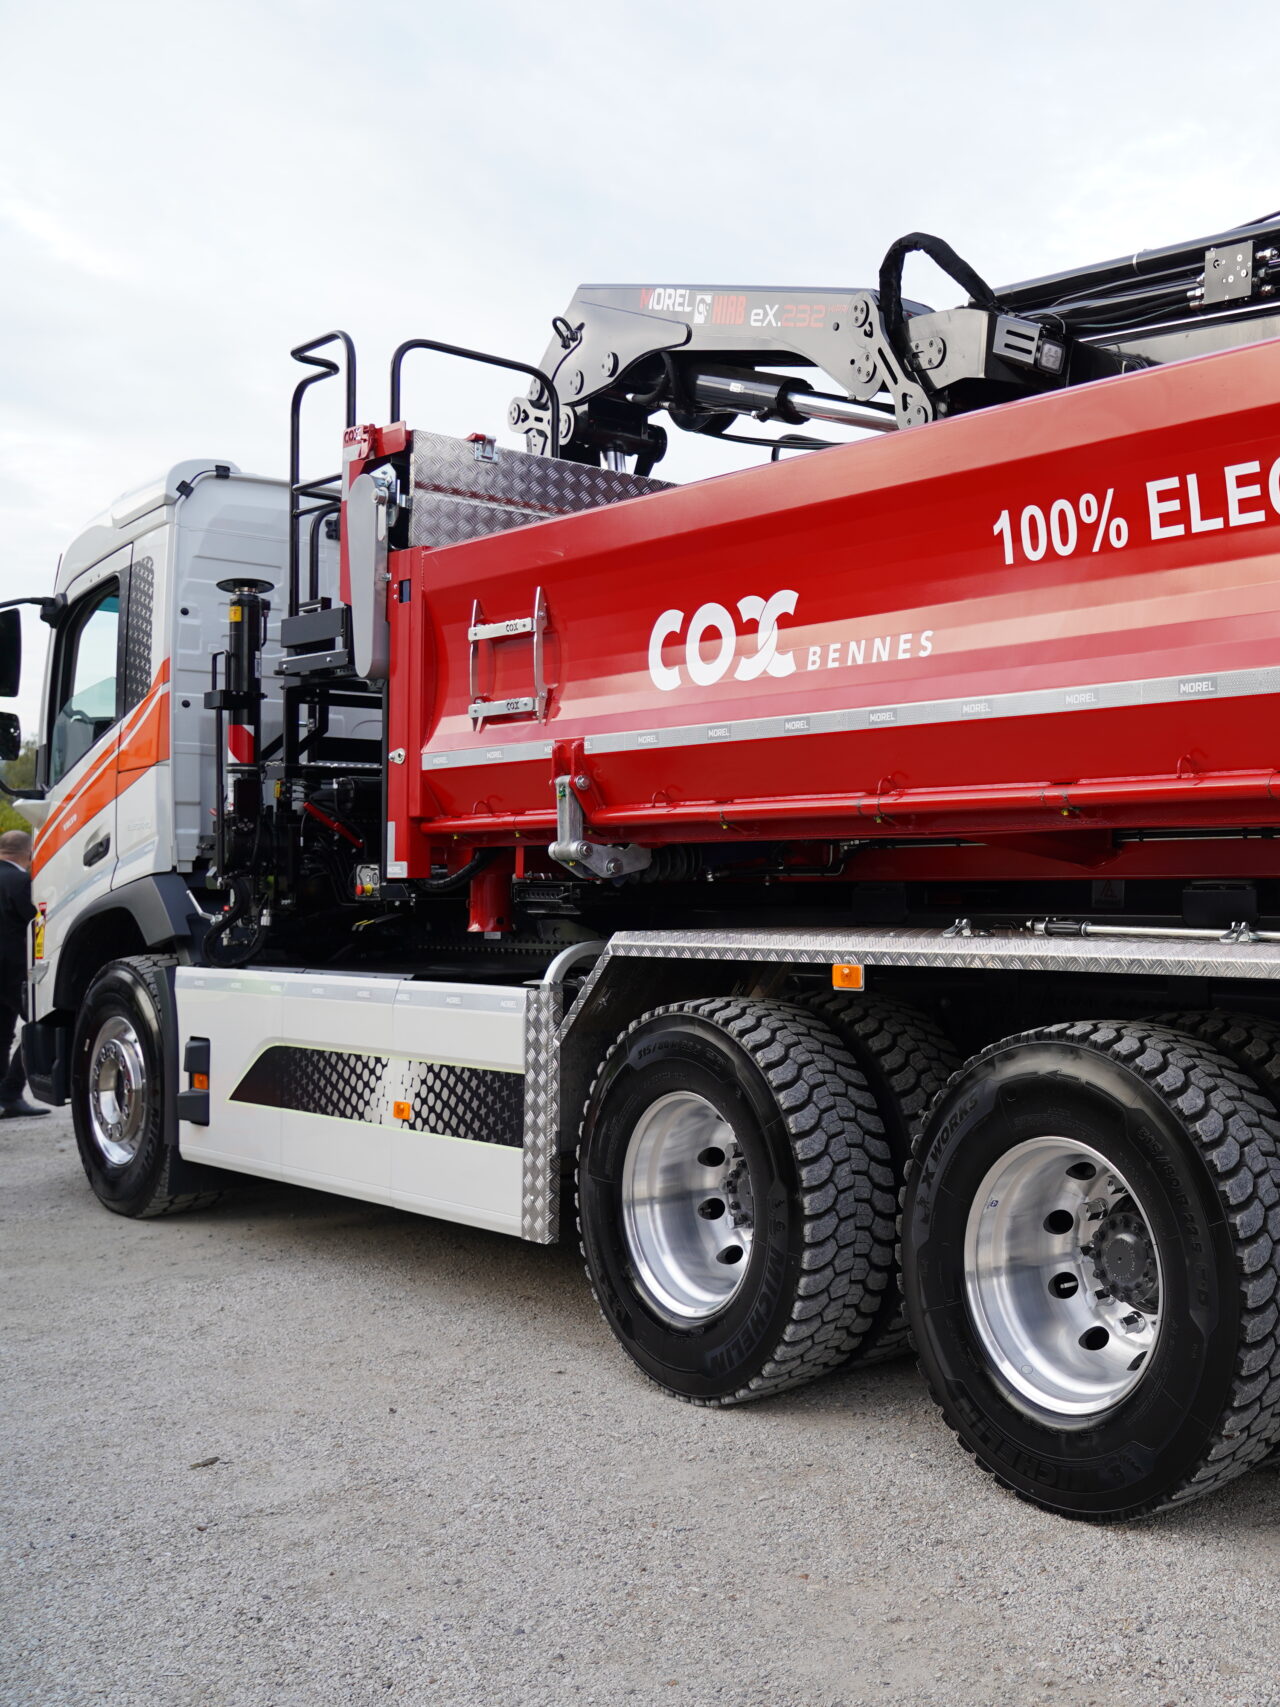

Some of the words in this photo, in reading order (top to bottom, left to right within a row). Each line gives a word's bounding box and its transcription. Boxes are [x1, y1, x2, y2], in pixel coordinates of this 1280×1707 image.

[640, 288, 693, 312] MOREL
[712, 295, 747, 325] HIAB
[993, 488, 1129, 565] 100%
[505, 623, 519, 632] COX
[648, 589, 799, 691] COX
[807, 630, 934, 671] BENNES
[1179, 680, 1215, 694] MOREL
[1065, 692, 1097, 706] MOREL
[506, 701, 519, 711] COX
[962, 702, 992, 714] MOREL
[869, 711, 895, 723] MOREL
[785, 720, 809, 731] MOREL
[708, 728, 730, 738] MOREL
[637, 735, 659, 744] MOREL
[930, 1091, 978, 1162] WORKS
